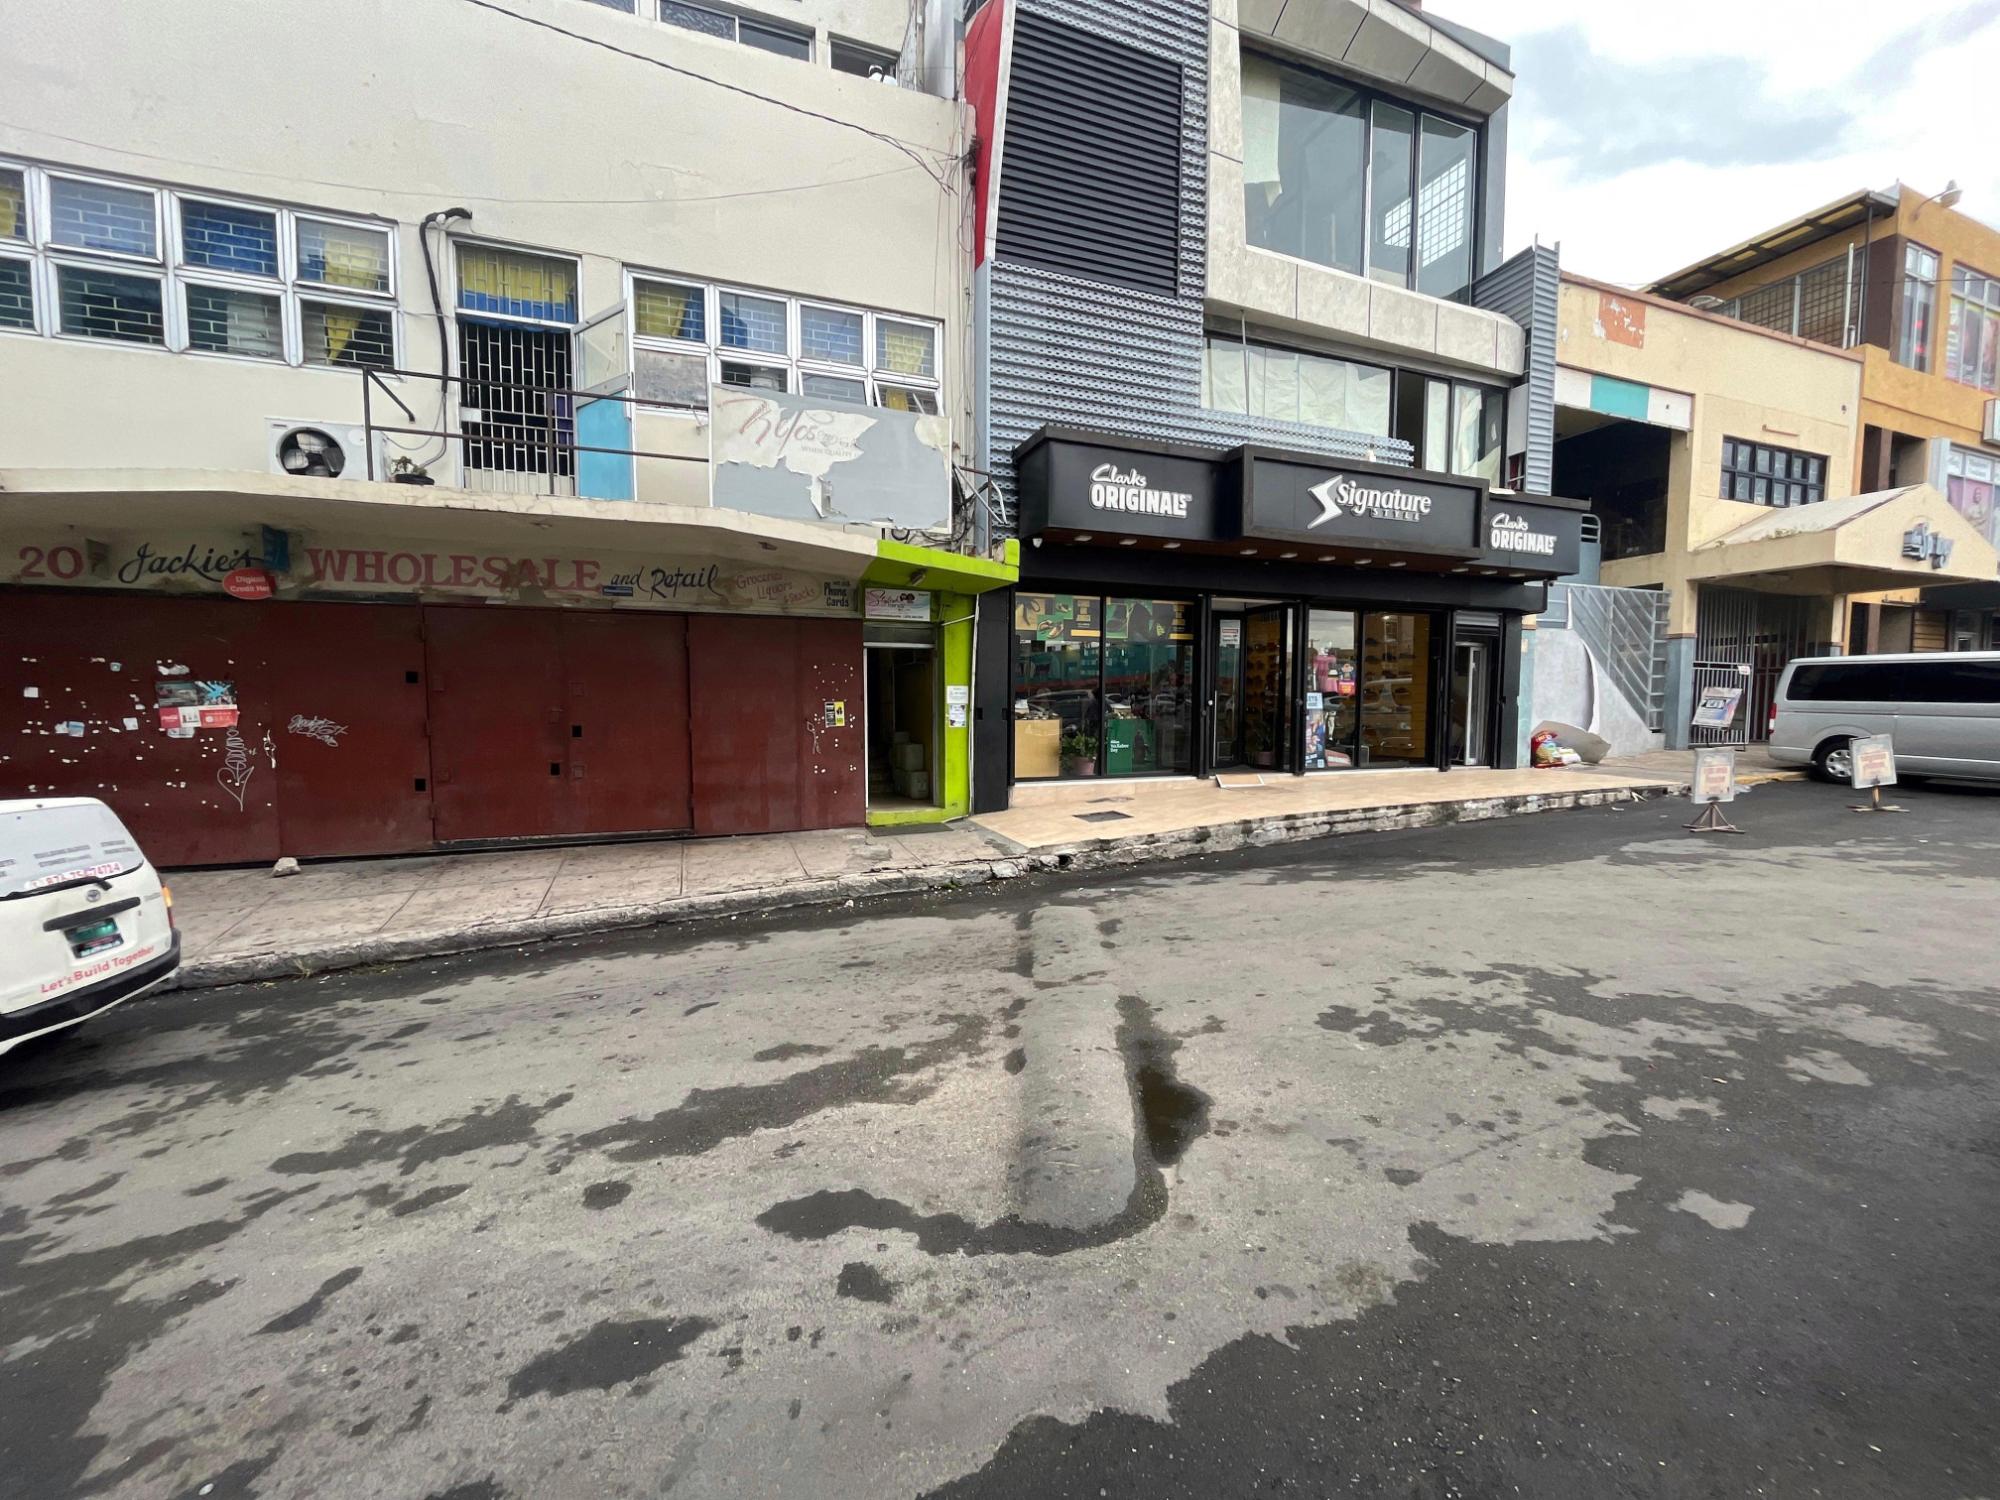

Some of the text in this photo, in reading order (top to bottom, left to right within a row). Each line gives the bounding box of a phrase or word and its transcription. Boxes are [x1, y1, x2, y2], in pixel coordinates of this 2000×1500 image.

[1091, 463, 1147, 487] Clarks
[1090, 484, 1192, 519] ORIGINALS
[1337, 480, 1432, 516] Signature
[1370, 507, 1421, 522] STYLE
[1491, 513, 1530, 532] Clarks
[1490, 528, 1558, 555] ORIGINALS
[18, 546, 85, 580] 20
[118, 543, 270, 584] Jackie's
[304, 548, 724, 600] WHOLESALE and Retail
[735, 573, 784, 589] Groceries
[757, 581, 793, 601] Liquors
[823, 582, 847, 596] Phone
[826, 597, 849, 607] Cards
[40, 976, 73, 994] Let's
[73, 961, 110, 980] Build
[112, 945, 155, 969] Together
